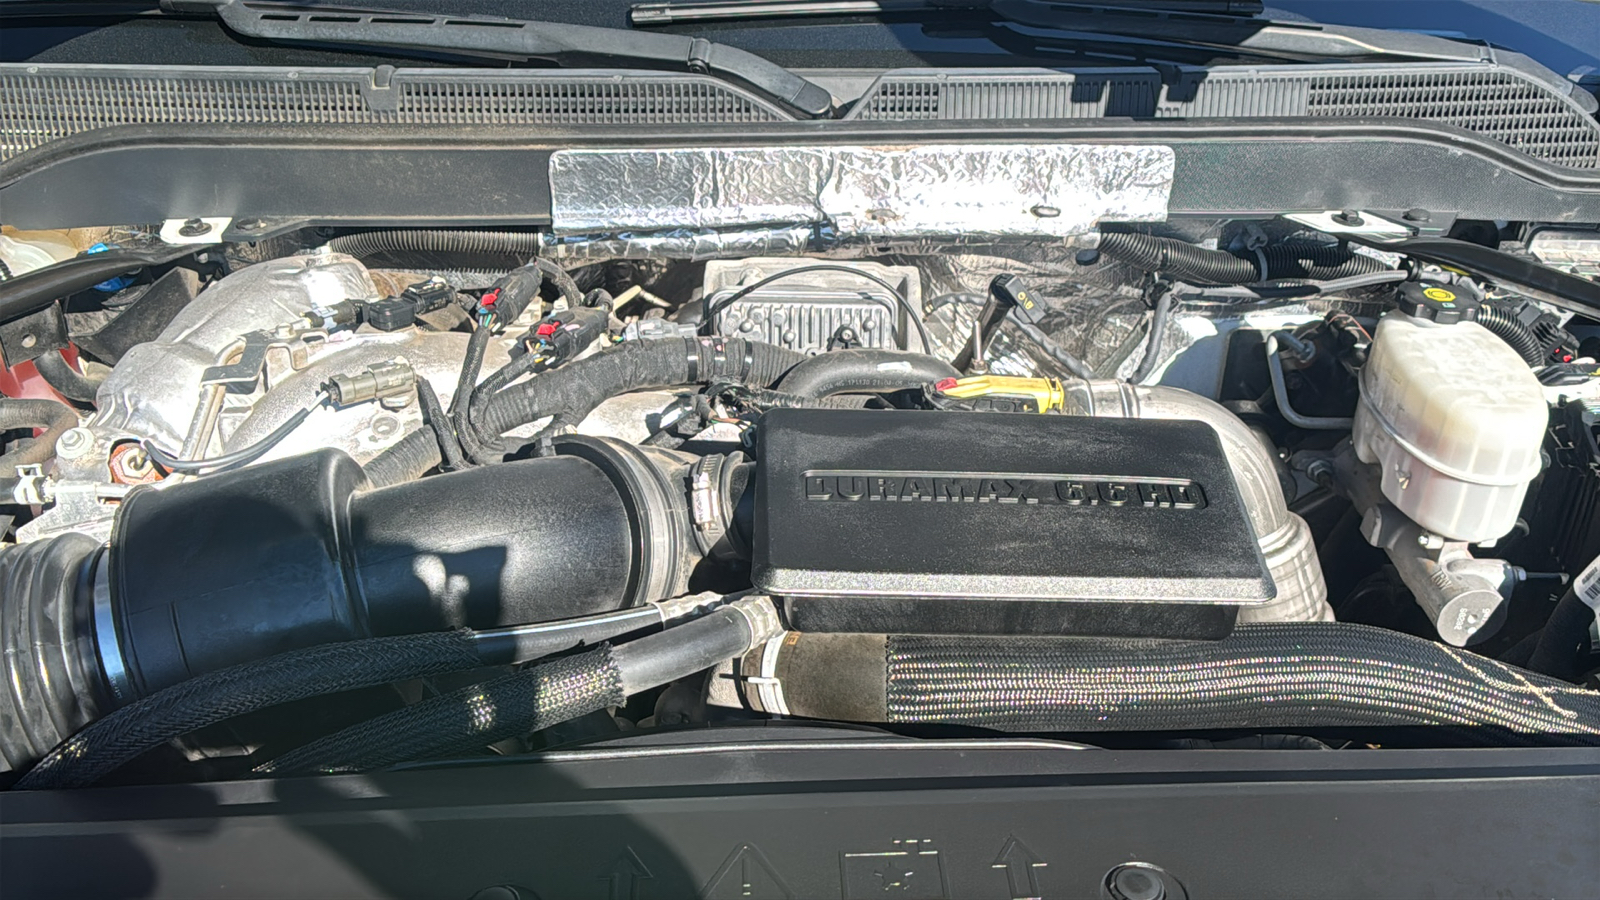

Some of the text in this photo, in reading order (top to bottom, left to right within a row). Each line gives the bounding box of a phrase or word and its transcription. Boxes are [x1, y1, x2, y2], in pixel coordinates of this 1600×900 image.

[805, 475, 1207, 509] DURAMAX 6.6 HD
